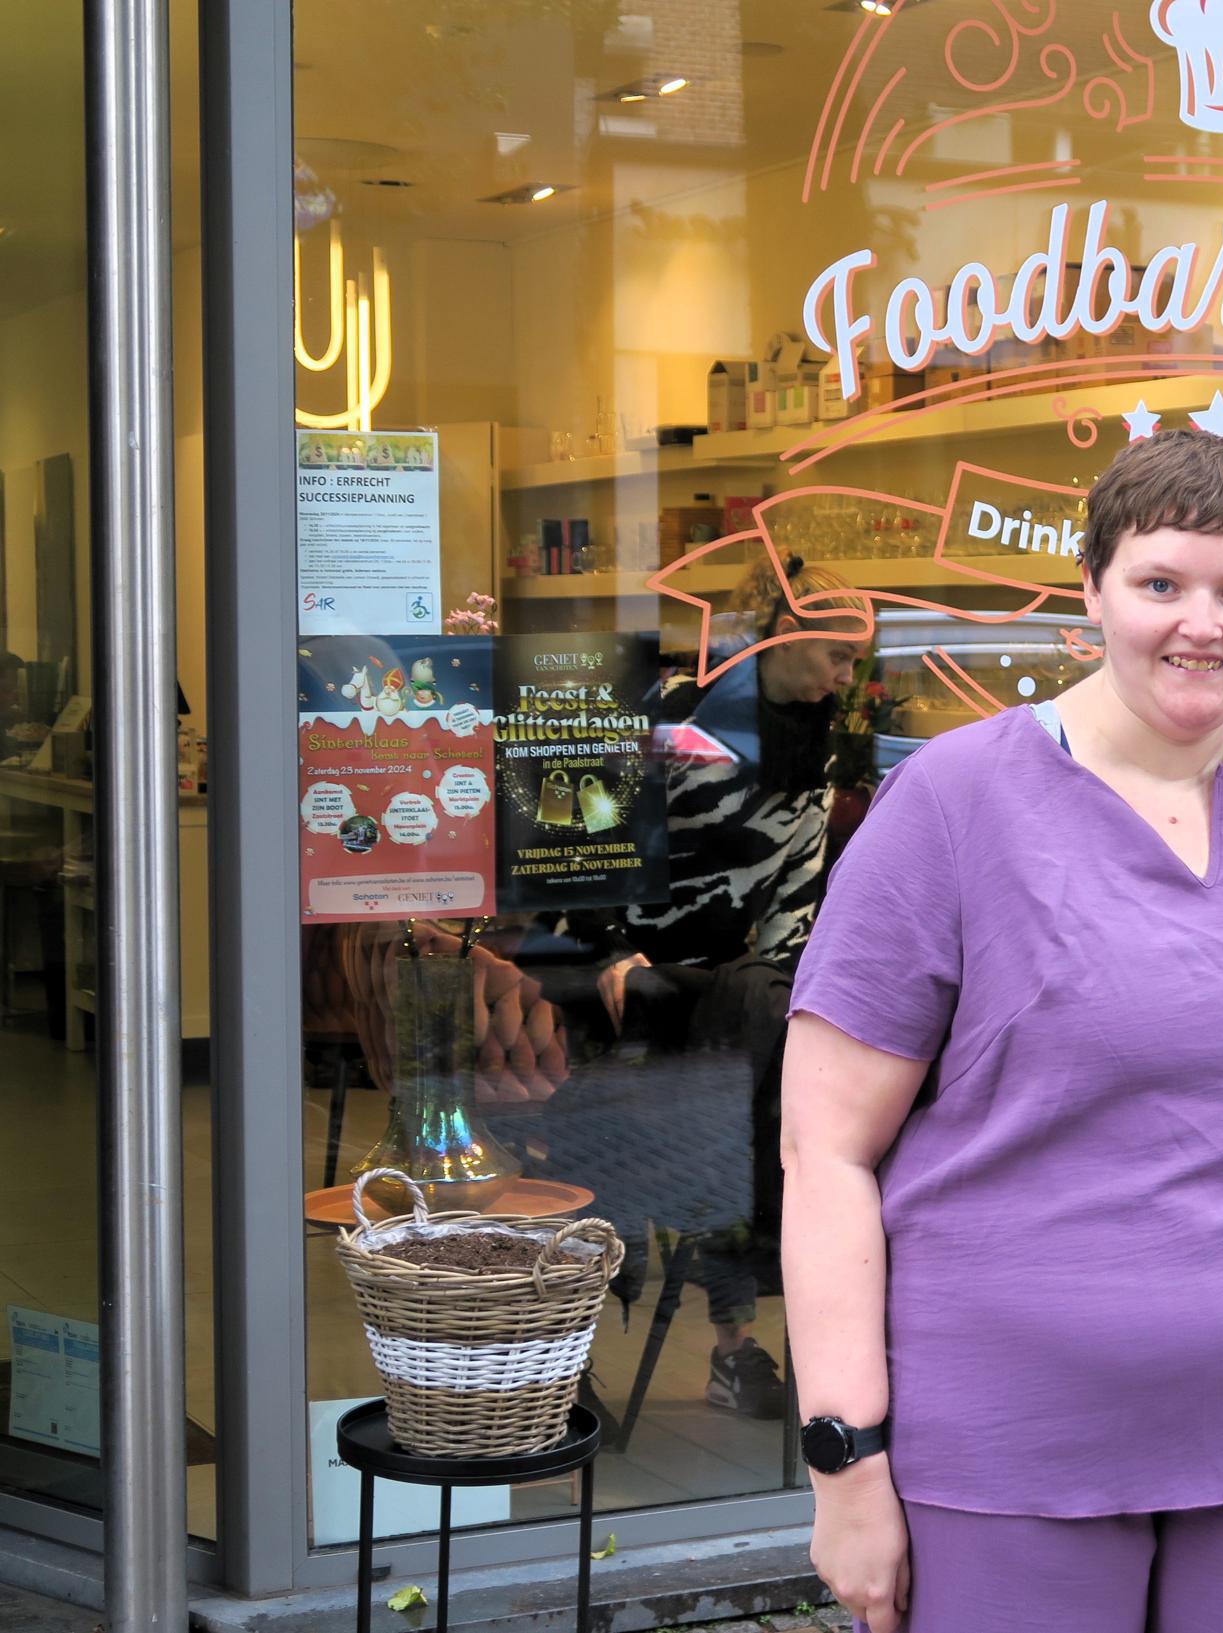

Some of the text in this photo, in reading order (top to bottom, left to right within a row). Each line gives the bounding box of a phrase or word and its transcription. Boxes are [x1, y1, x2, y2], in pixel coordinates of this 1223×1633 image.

[299, 475, 327, 486] INFO
[336, 476, 391, 487] ERFRECHT
[299, 491, 416, 504] SUCCESSIEPLANNING
[533, 652, 579, 666] GENIET
[518, 682, 620, 712] Feest &
[493, 711, 650, 744] Glitterdagen
[505, 742, 639, 758] KOM SHOPPEN EN GENIETEN
[387, 765, 412, 774] 2024
[543, 756, 605, 769] in de Paalstraat
[516, 842, 636, 859] VRIJDAG 15 NOVEMBER
[511, 857, 642, 875] ZATERDAG 16 NOVEMBER
